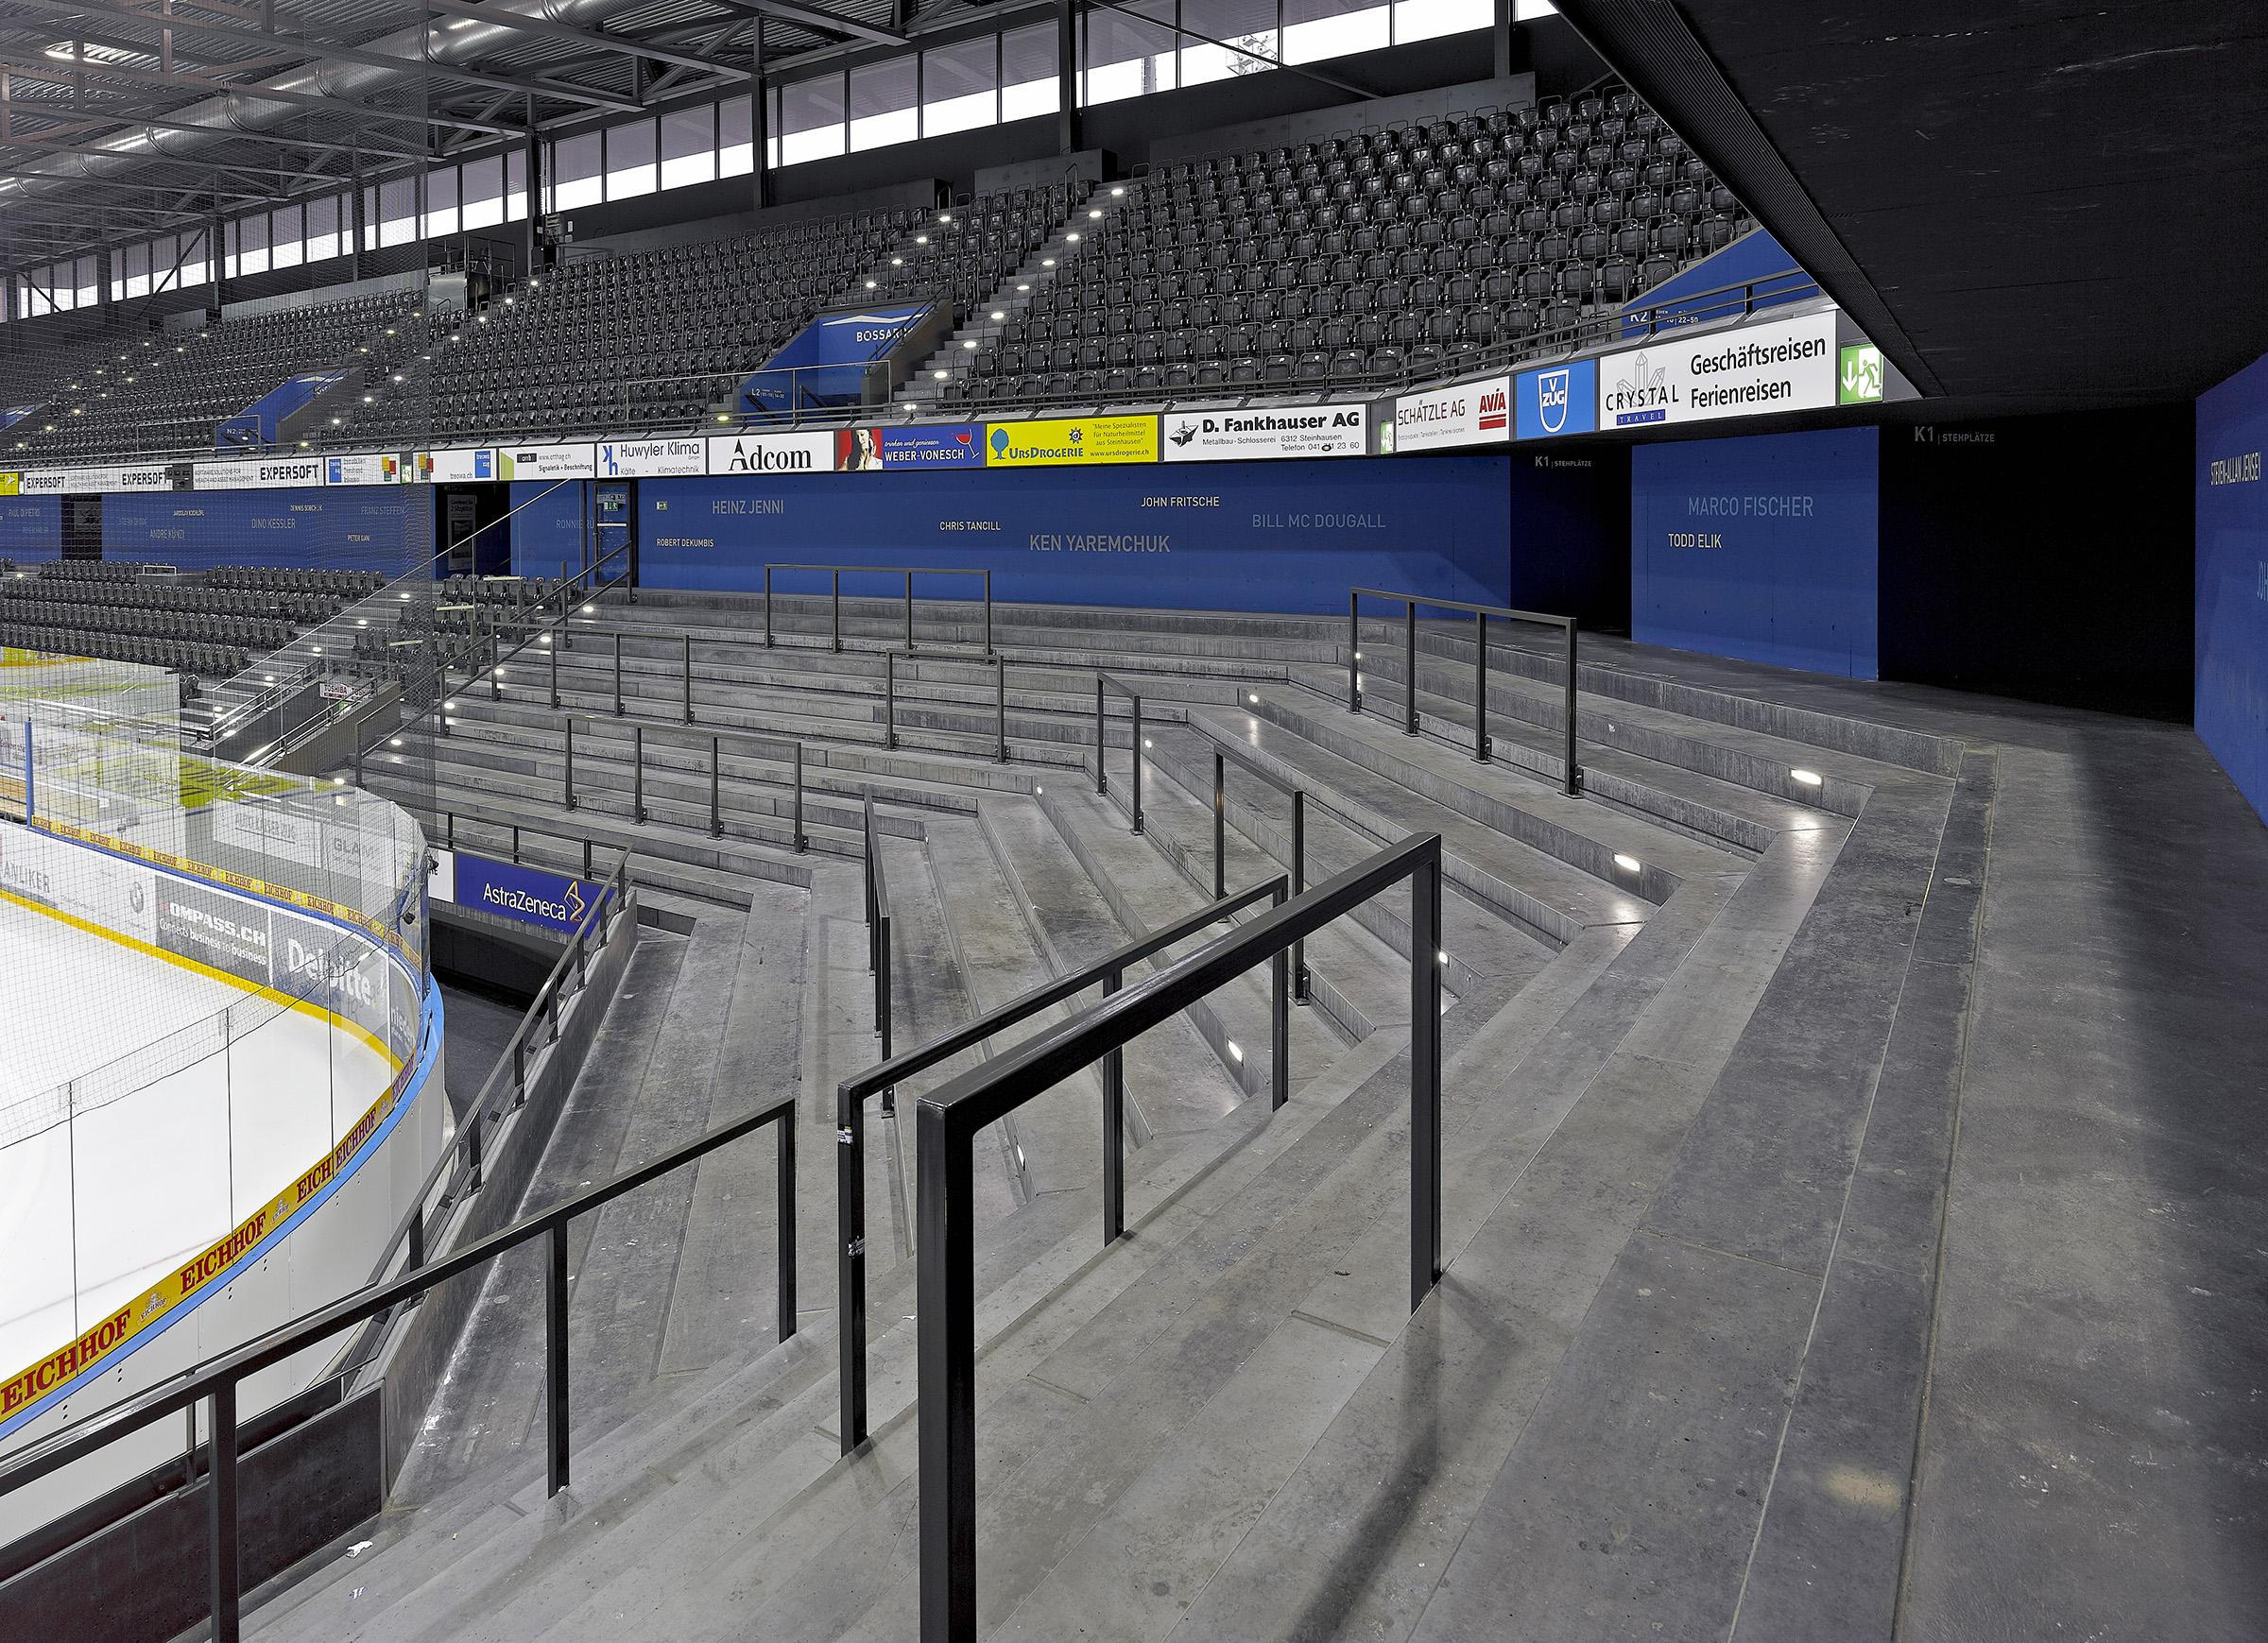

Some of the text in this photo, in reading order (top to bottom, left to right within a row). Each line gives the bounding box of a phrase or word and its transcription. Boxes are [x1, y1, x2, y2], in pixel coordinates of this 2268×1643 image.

[1692, 337, 1826, 375] Geschäftsreisen
[1549, 378, 1557, 390] V
[1542, 391, 1564, 407] ZUG
[1606, 385, 1679, 411] CRYSTAL
[1692, 379, 1792, 408] Ferienreisen
[1398, 399, 1466, 426] SCHÄTZLE AG
[1620, 412, 1662, 423] TRAVEL
[1113, 421, 1146, 431] Spezialisten
[1203, 412, 1360, 433] D. Fankhauser AG
[1093, 429, 1145, 438] für Naturheilmittel
[1299, 434, 1342, 442] Steinhausen
[1915, 426, 1995, 443] K1 STEHPLÄTZE
[621, 441, 700, 459] Huwyler Klima
[729, 438, 813, 471] Adcom
[1090, 448, 1150, 457] www.ursdrogerie.ch
[1281, 443, 1305, 452] Telefon
[885, 449, 965, 462] WEBER-VONESCH
[1535, 456, 1592, 468] K1 STEHPLÄTZE
[260, 464, 319, 481] EXPERSOFT
[539, 464, 559, 473] Signaletik
[564, 462, 593, 472] Beschriftung
[657, 465, 700, 474] Klimatechnik
[26, 476, 66, 489] EXPERSOFT
[122, 471, 167, 486] EXPERSOFT
[712, 499, 784, 514] HEINZ JENNI
[1141, 496, 1220, 507] JOHN FRITSCHE
[1688, 496, 1813, 517] MARCO FISCHER
[251, 518, 296, 529] DINO KESSLER
[556, 520, 583, 529] RONNIE
[939, 521, 1001, 531] CHRIS TANCILL
[1252, 514, 1386, 528] BILL MC DOUGALL
[657, 539, 714, 548] ROBERT DEKUMBIS
[1030, 534, 1171, 553] KEN YAREMCHUK
[1668, 533, 1723, 549] TODD ELIK
[324, 684, 348, 694] TOSHIBA
[3, 861, 50, 894] ANLIKER
[119, 841, 142, 856] EICHHOF
[153, 850, 178, 867] EICHHOF
[187, 861, 213, 878] EICHHOF
[225, 872, 252, 889] EICHHOF
[265, 882, 293, 900] EICHHOF
[307, 895, 335, 914] EICHHOF
[483, 882, 567, 921] AstraZeneca
[190, 928, 221, 950] business
[232, 942, 266, 966] business
[1, 1309, 131, 1415] EICHHOF
[180, 1211, 266, 1295] EICHHOF
[335, 1107, 377, 1170] EICHHOF
